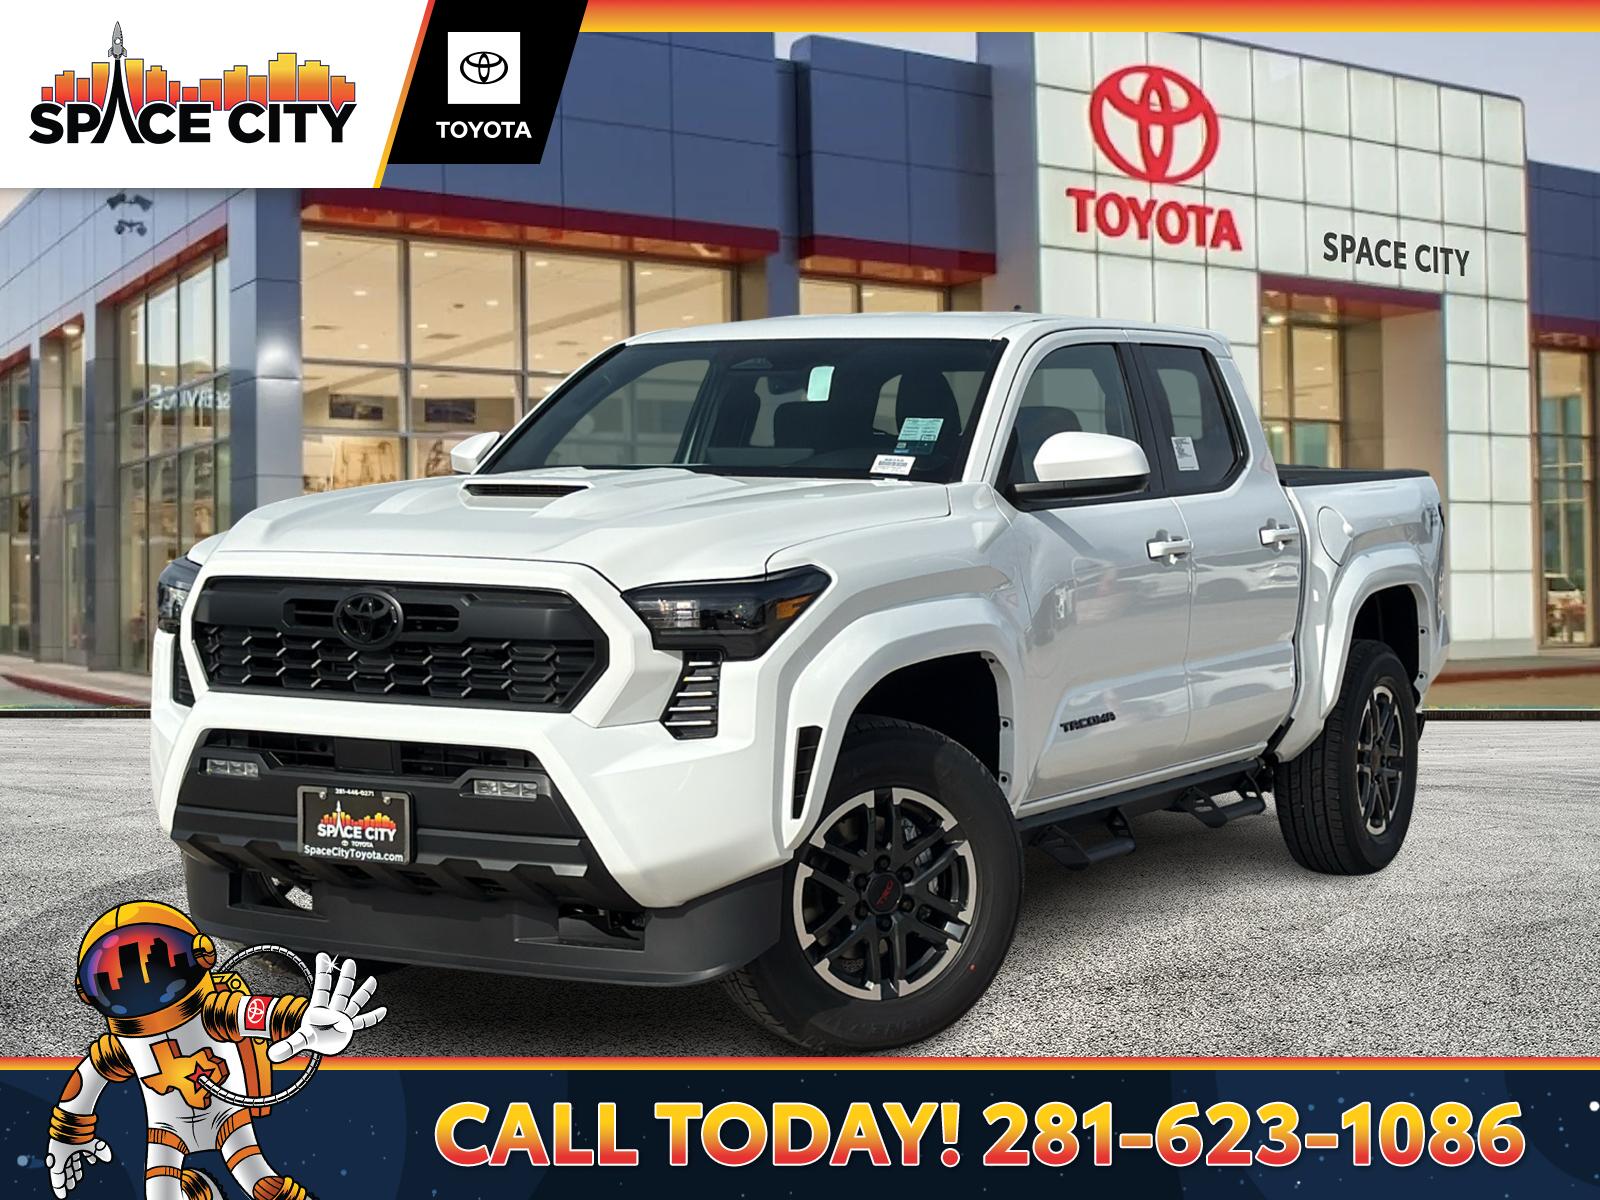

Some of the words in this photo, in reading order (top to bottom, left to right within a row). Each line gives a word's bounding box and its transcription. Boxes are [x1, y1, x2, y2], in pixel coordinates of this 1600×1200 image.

[1066, 187, 1243, 252] TOYOTA
[1322, 231, 1408, 270] SPACE
[1414, 244, 1471, 277] CITY
[365, 826, 397, 842] CITY
[351, 840, 374, 849] TOYOTA
[303, 845, 404, 862] SpaceCityToyota.com
